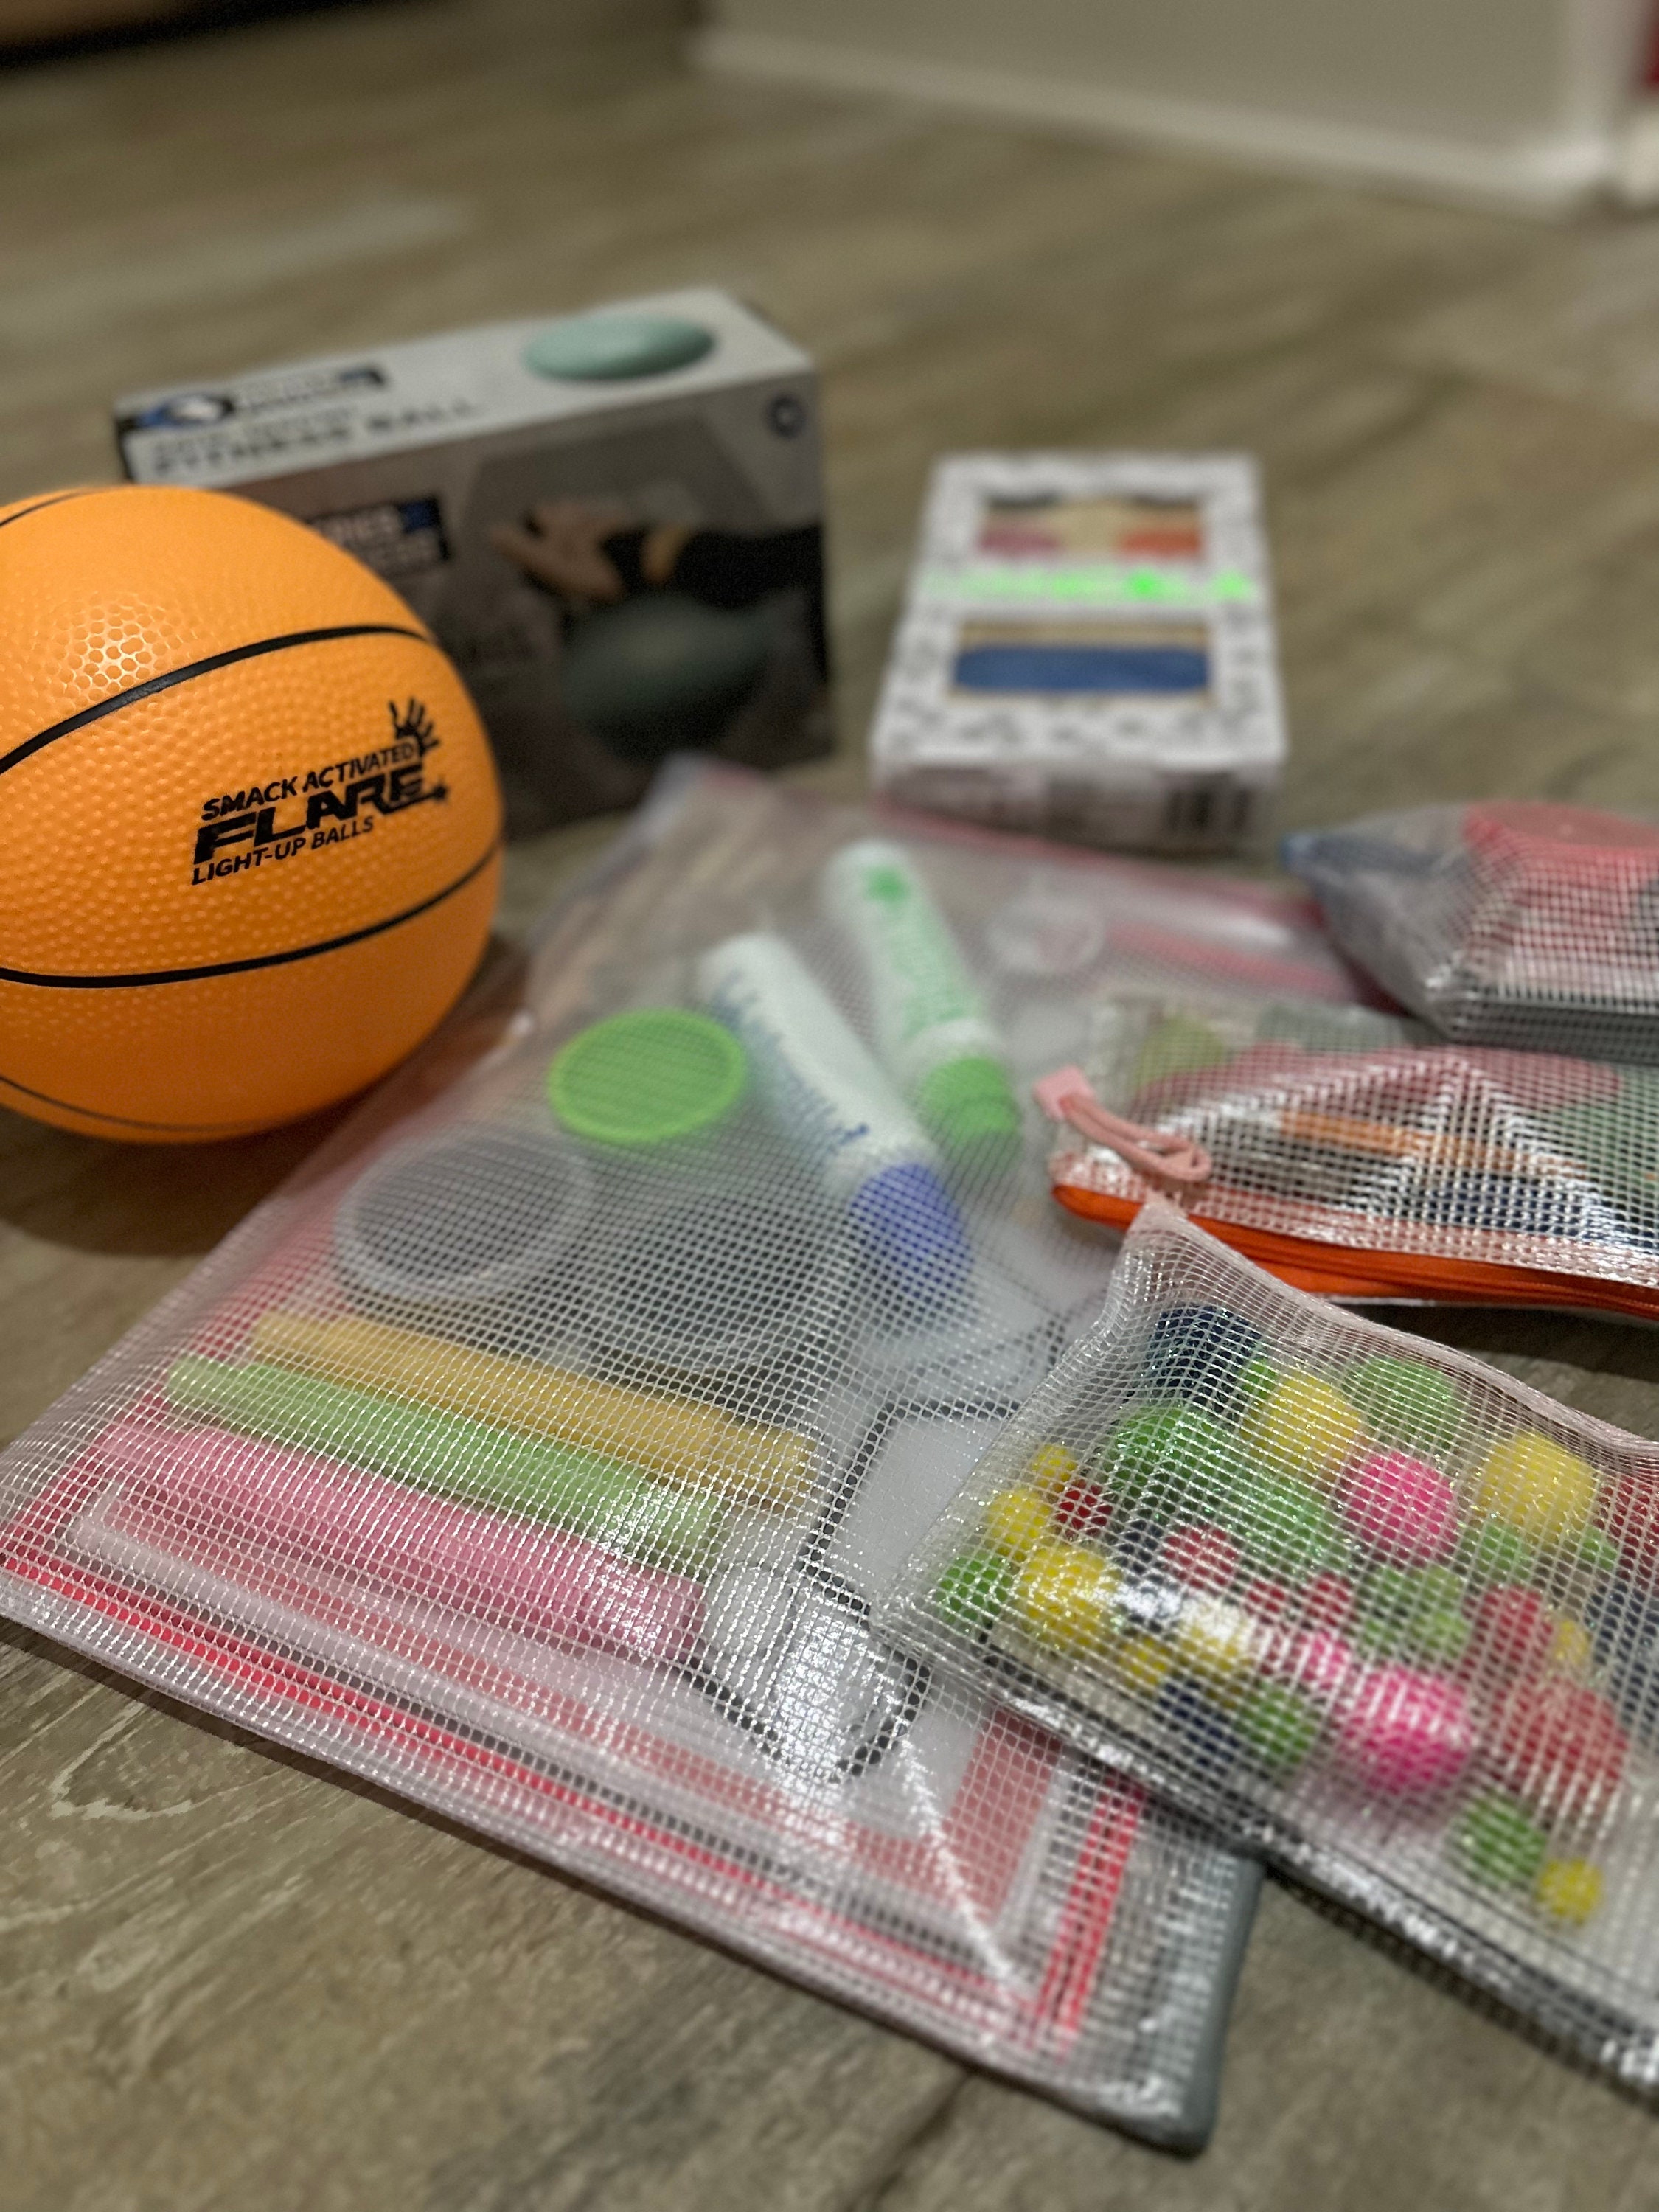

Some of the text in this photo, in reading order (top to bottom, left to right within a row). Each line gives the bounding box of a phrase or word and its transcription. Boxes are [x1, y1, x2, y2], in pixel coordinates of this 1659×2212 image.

[193, 762, 447, 866] FLARE
[201, 742, 415, 821] SMACK ACTIVATED
[192, 815, 375, 886] LIGHT-UP BALLS
